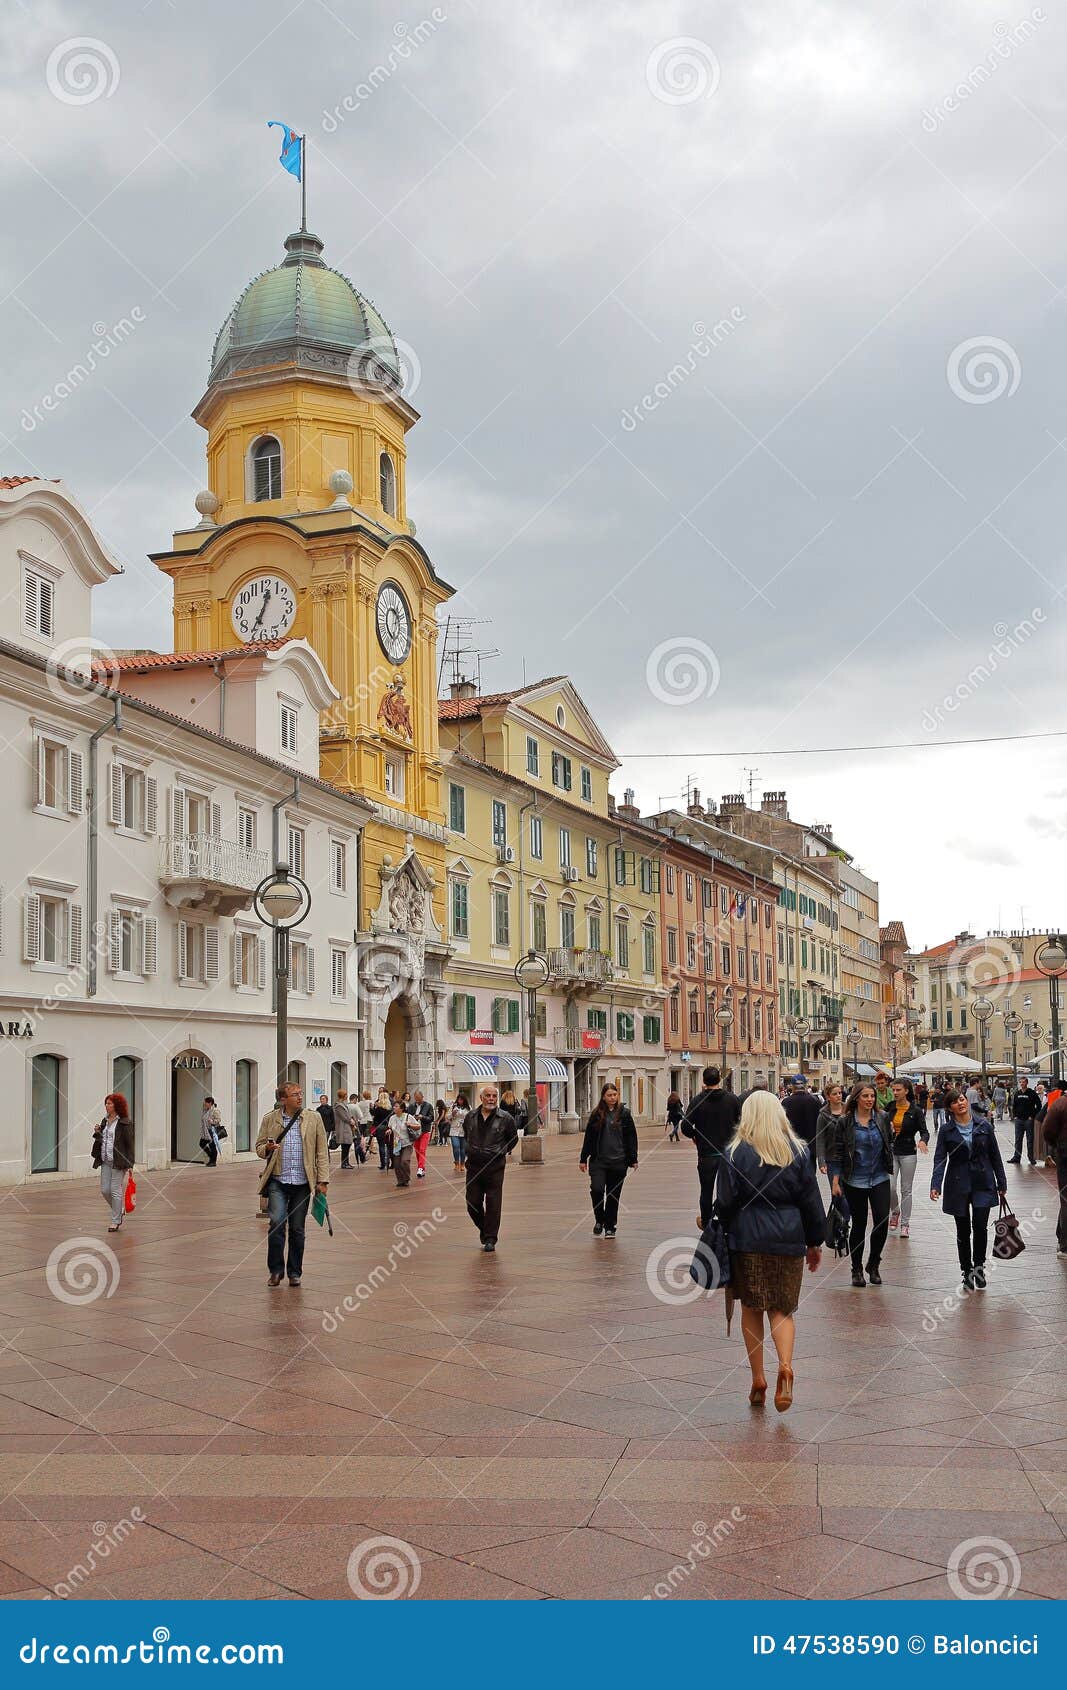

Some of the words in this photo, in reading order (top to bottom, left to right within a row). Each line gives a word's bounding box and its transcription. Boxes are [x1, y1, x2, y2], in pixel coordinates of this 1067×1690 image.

[249, 582, 258, 597] 11
[260, 579, 271, 593] 12
[274, 581, 279, 595] 1
[239, 591, 250, 605] 10
[280, 587, 288, 600] 2
[235, 606, 244, 620] 9
[285, 600, 293, 615] 3
[240, 619, 249, 634] 8
[280, 614, 288, 628] 4
[270, 624, 279, 639] 5
[0, 1021, 34, 1037] ARA
[306, 1036, 332, 1047] ZARA
[173, 1056, 209, 1069] ZARA
